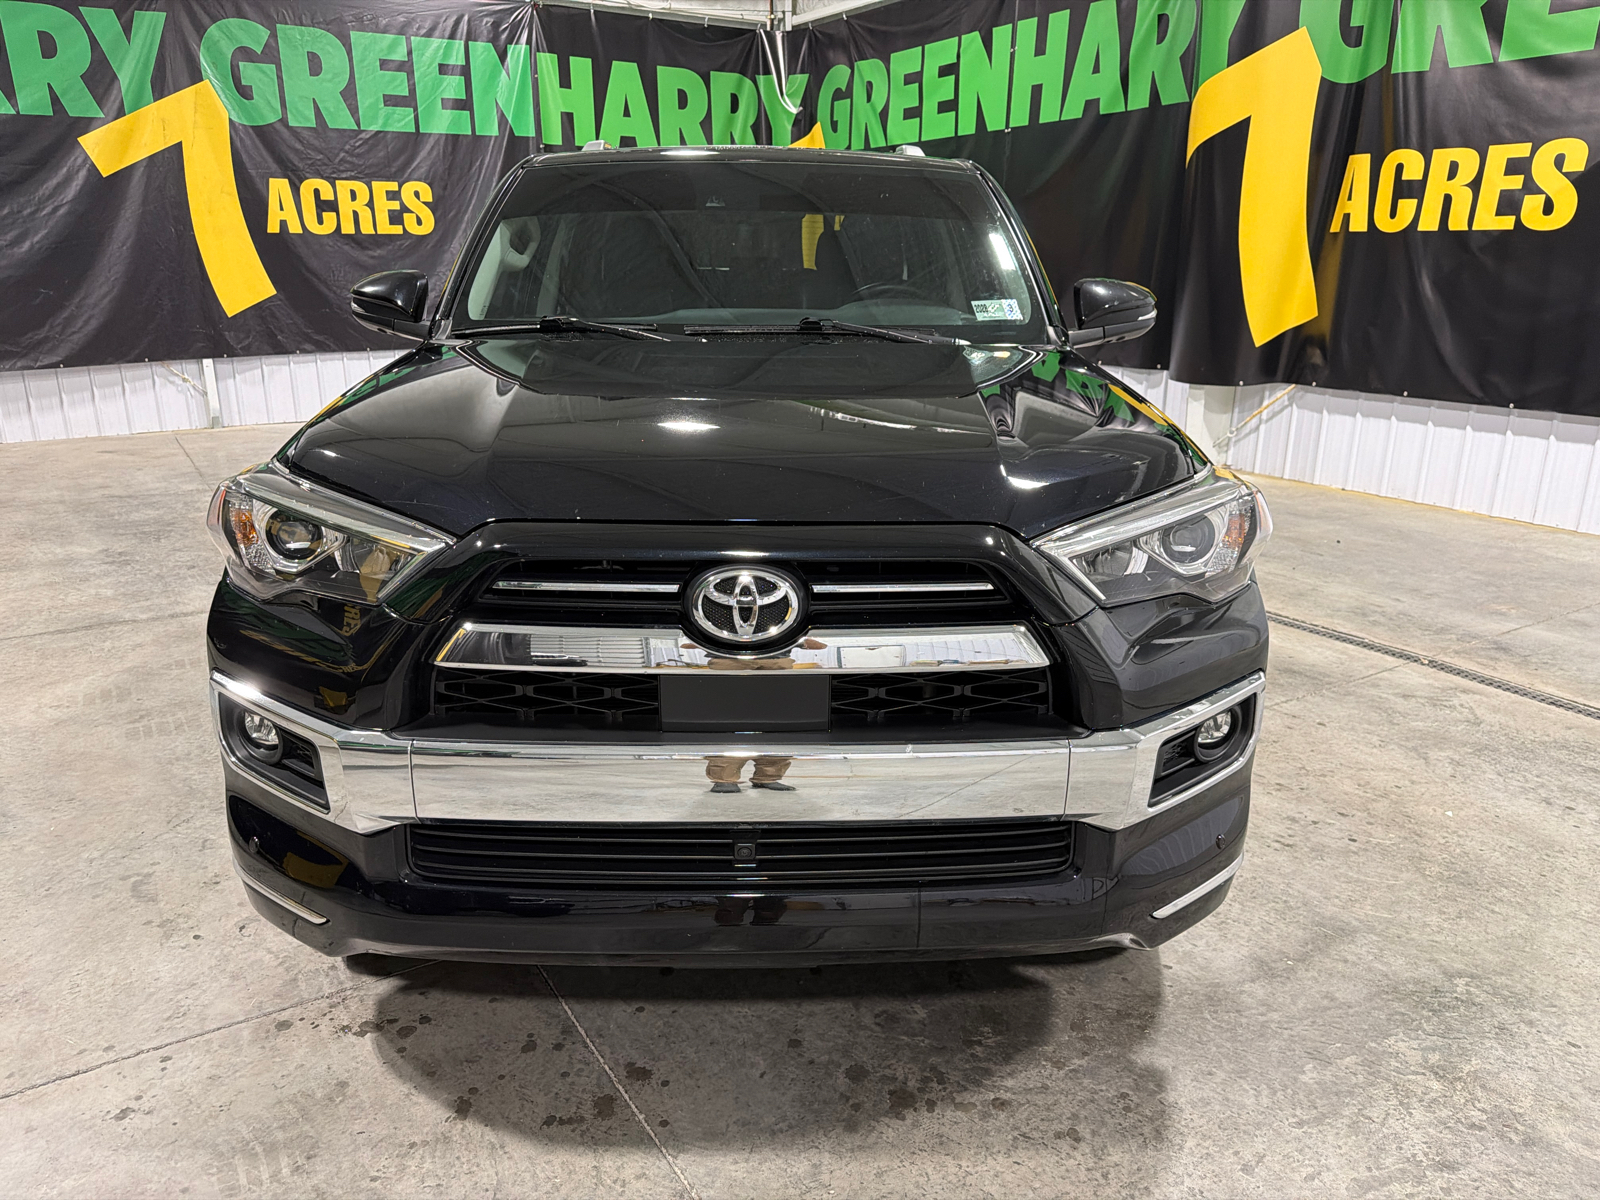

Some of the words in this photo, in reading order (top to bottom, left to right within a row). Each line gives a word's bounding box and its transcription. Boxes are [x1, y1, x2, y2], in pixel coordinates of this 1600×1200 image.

[0, 0, 166, 118] RY
[200, 18, 535, 137] GREEN
[536, 52, 808, 147] HARRY
[817, 24, 1012, 150] GREEN
[77, 79, 277, 318] 7
[267, 178, 434, 236] ACRES
[1187, 26, 1322, 347] 7
[1330, 137, 1589, 233] ACRES
